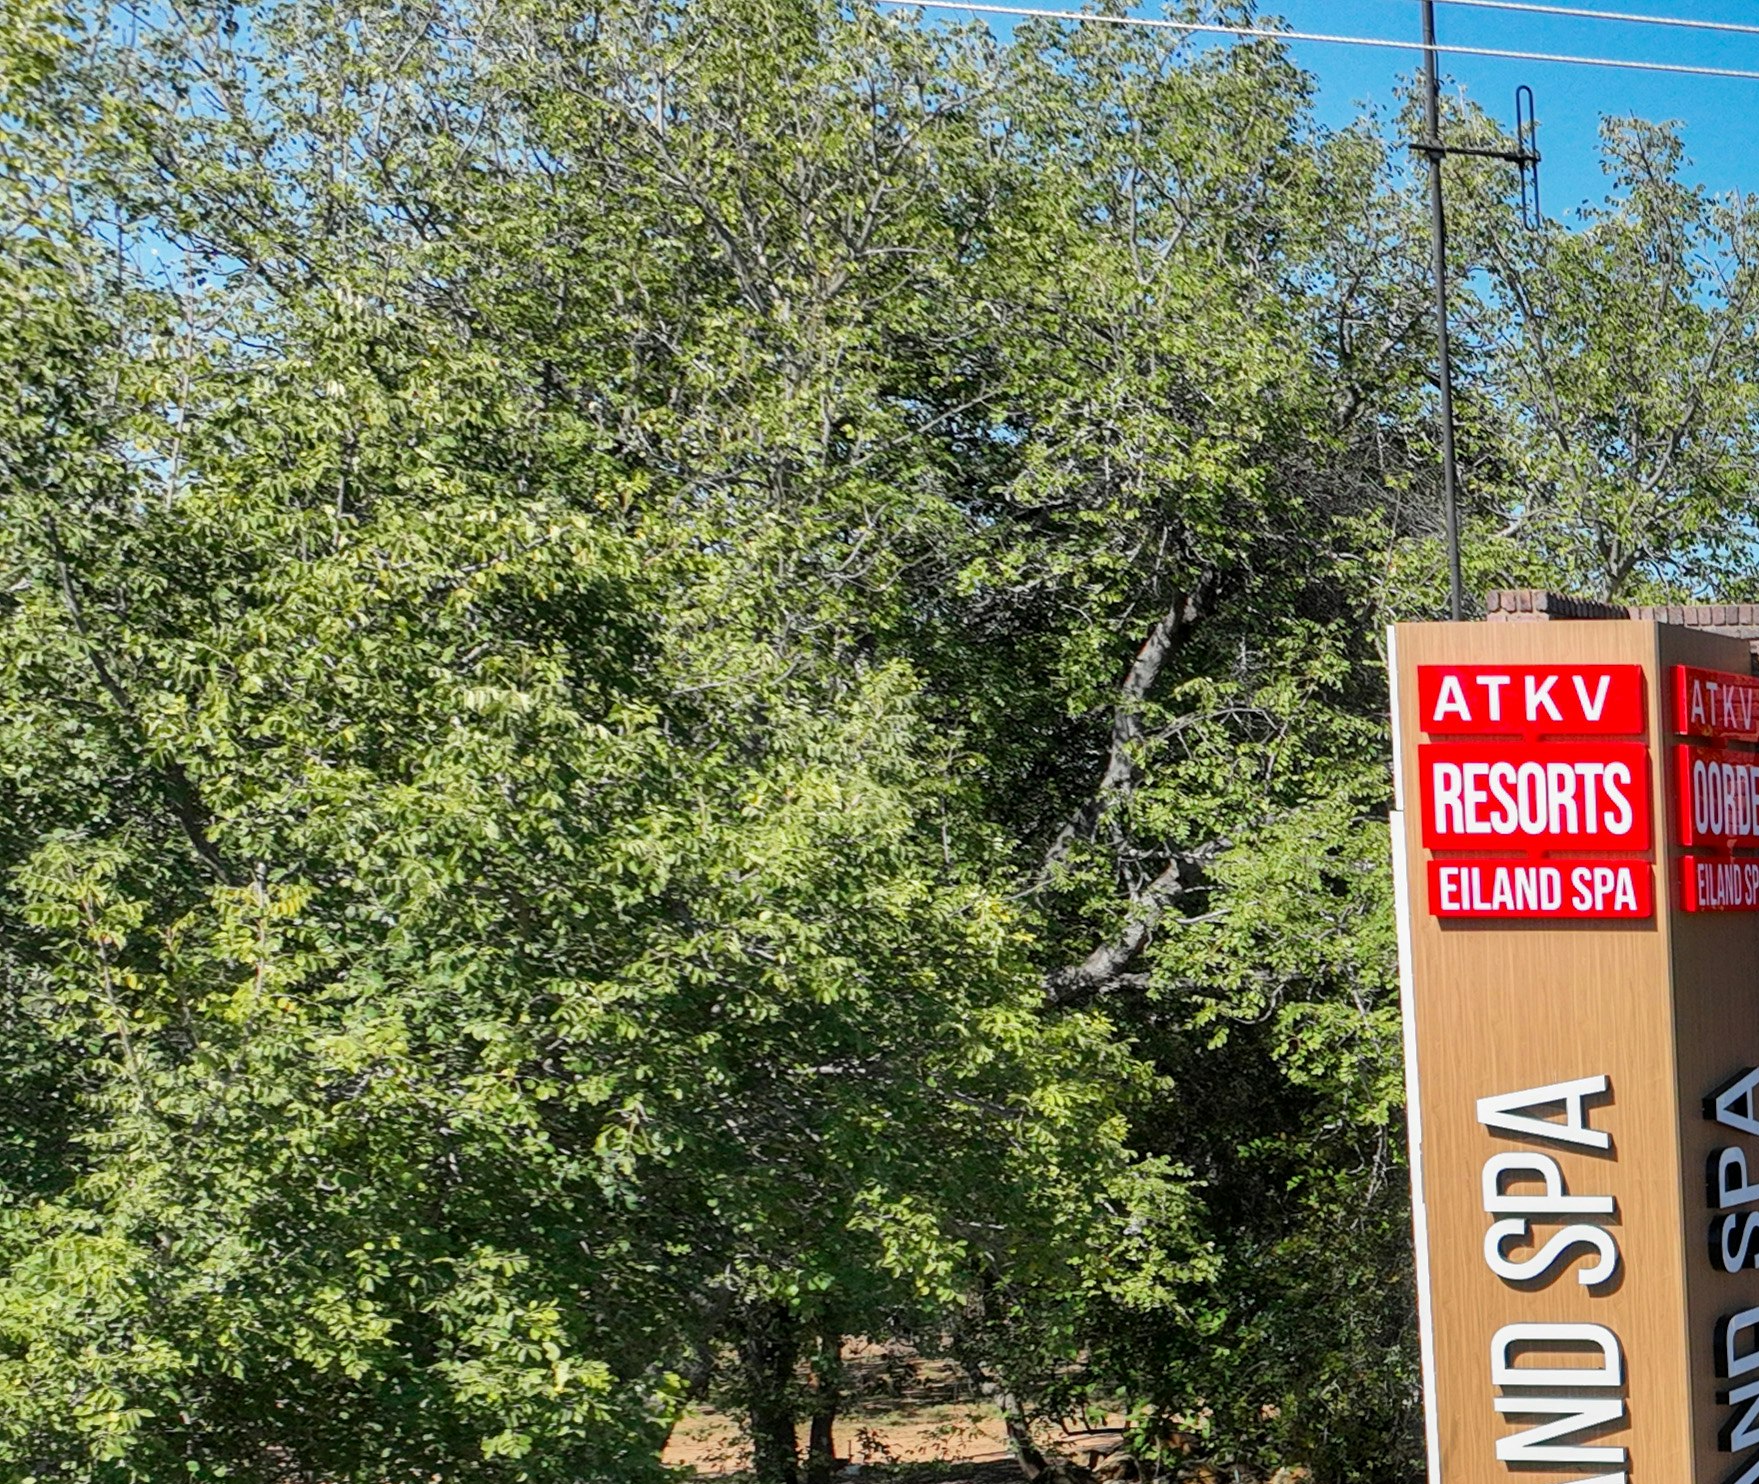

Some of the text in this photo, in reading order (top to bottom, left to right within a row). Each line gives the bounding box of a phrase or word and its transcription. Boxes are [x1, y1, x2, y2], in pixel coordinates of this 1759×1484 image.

[1432, 762, 1633, 835] RESORTS
[1440, 867, 1637, 912] EILAND SPA
[1697, 862, 1741, 906] EILAND
[1477, 1074, 1619, 1286] SPA
